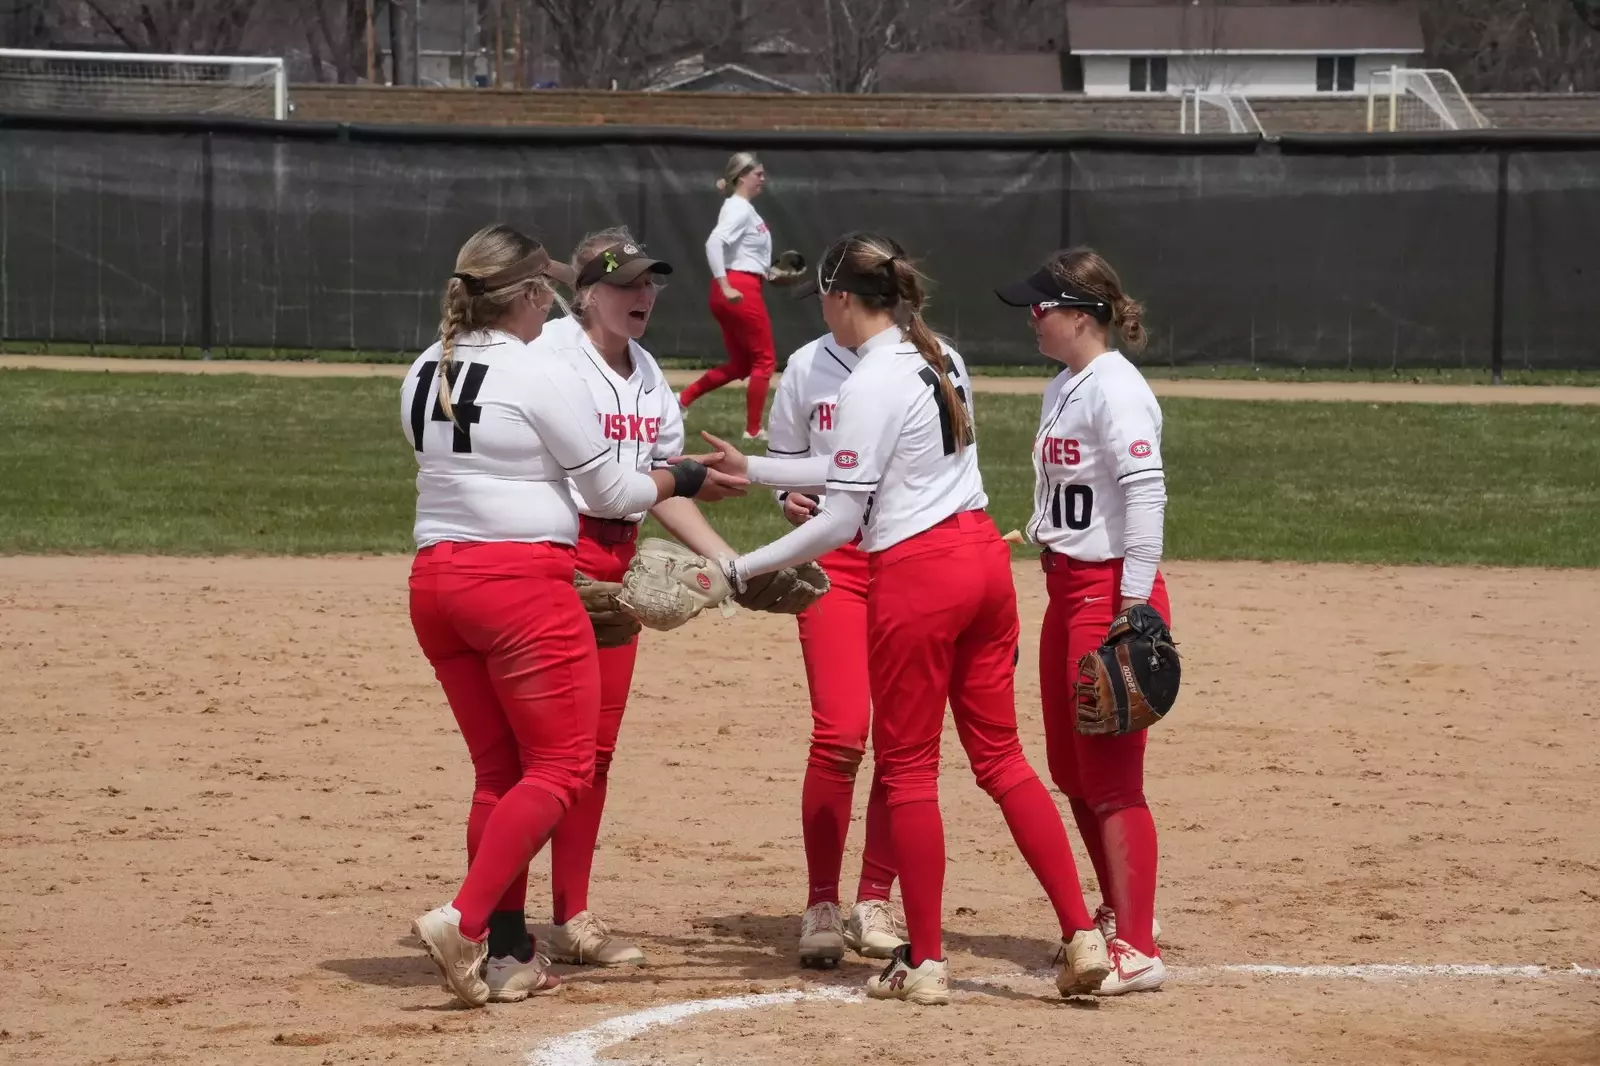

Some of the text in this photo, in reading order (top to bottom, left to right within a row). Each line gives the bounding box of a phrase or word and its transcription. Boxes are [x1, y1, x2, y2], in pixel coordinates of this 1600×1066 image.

[411, 361, 490, 453] 14
[818, 403, 837, 432] H
[1052, 483, 1093, 530] 10
[1122, 665, 1137, 693] A2000
